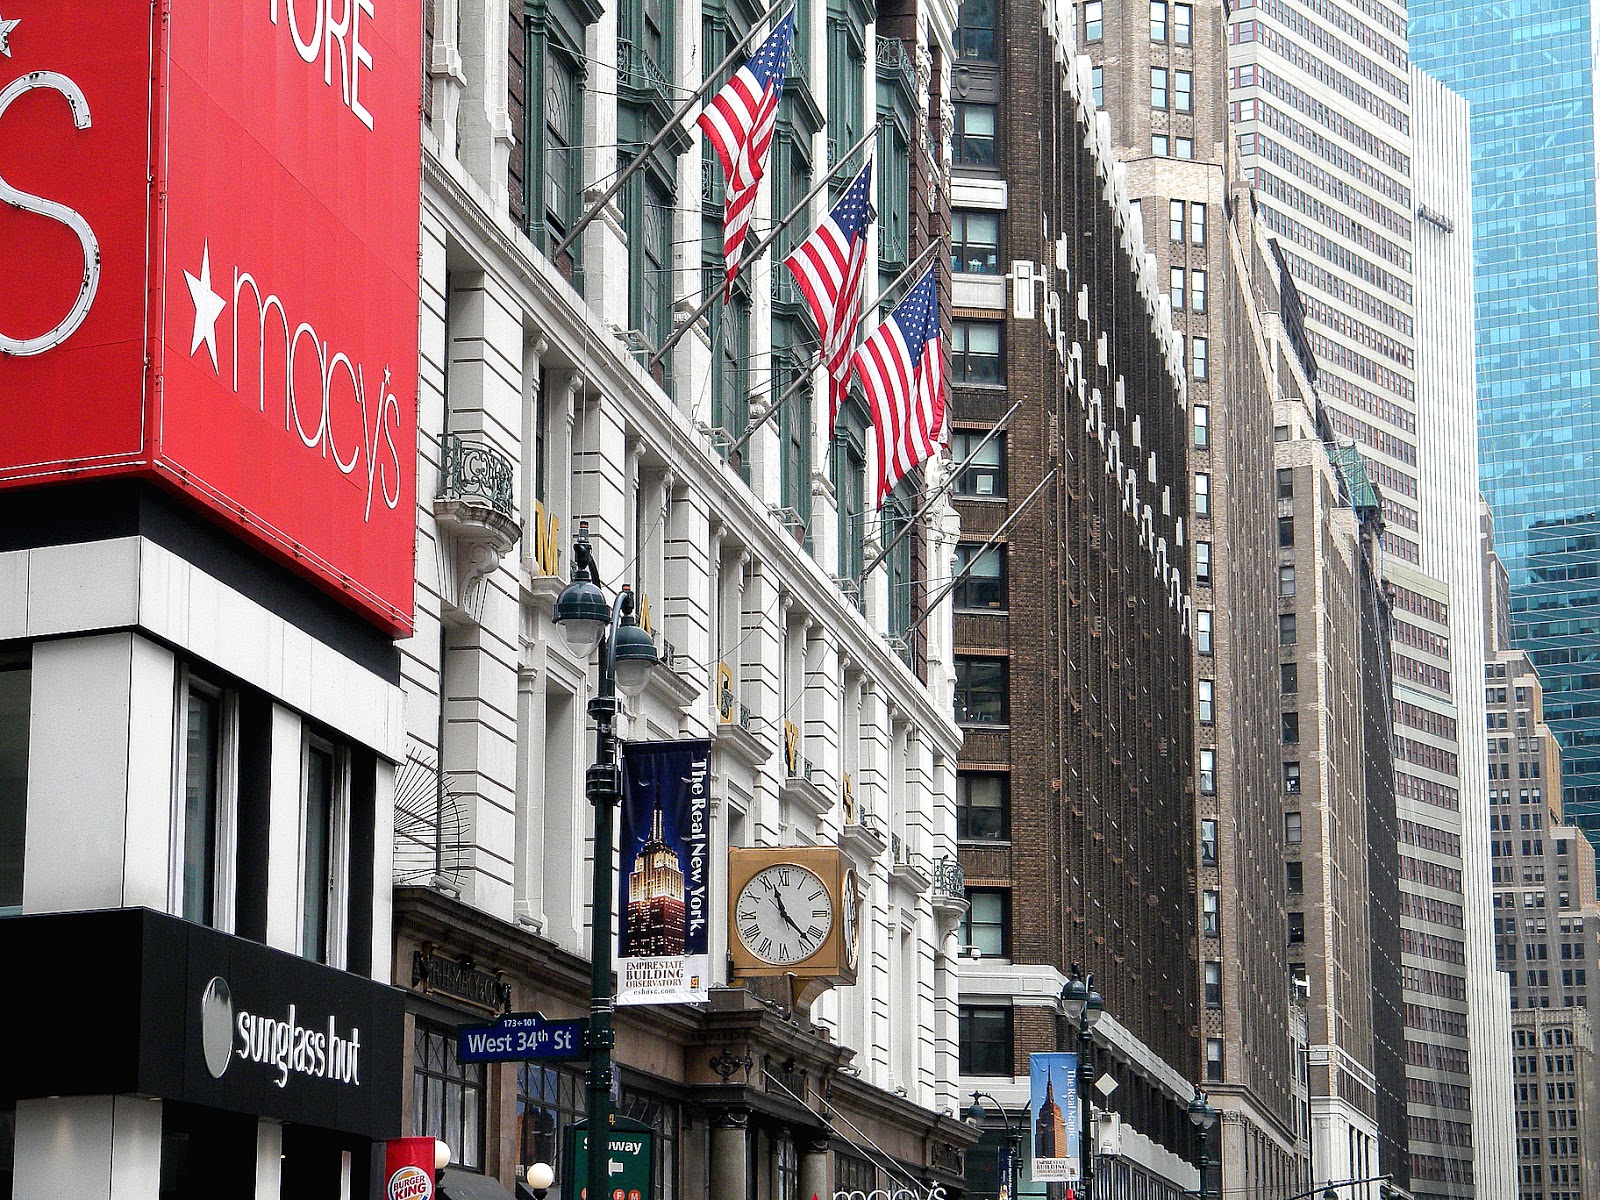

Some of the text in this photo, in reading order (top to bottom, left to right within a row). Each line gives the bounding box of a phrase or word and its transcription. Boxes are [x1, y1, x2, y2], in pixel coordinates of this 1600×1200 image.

[270, 0, 374, 132] ORE
[690, 758, 707, 937] The Real New York.
[626, 960, 684, 970] EMPIRE STATE
[626, 969, 684, 980] BUILDING
[625, 979, 684, 988] OBSERVATORY
[236, 1004, 360, 1088] sunglass hut
[468, 1029, 572, 1053] West 34th St
[1067, 1069, 1076, 1087] The
[1067, 1088, 1076, 1109] Real
[583, 1137, 642, 1155] way
[394, 1175, 426, 1200] BURGER KING
